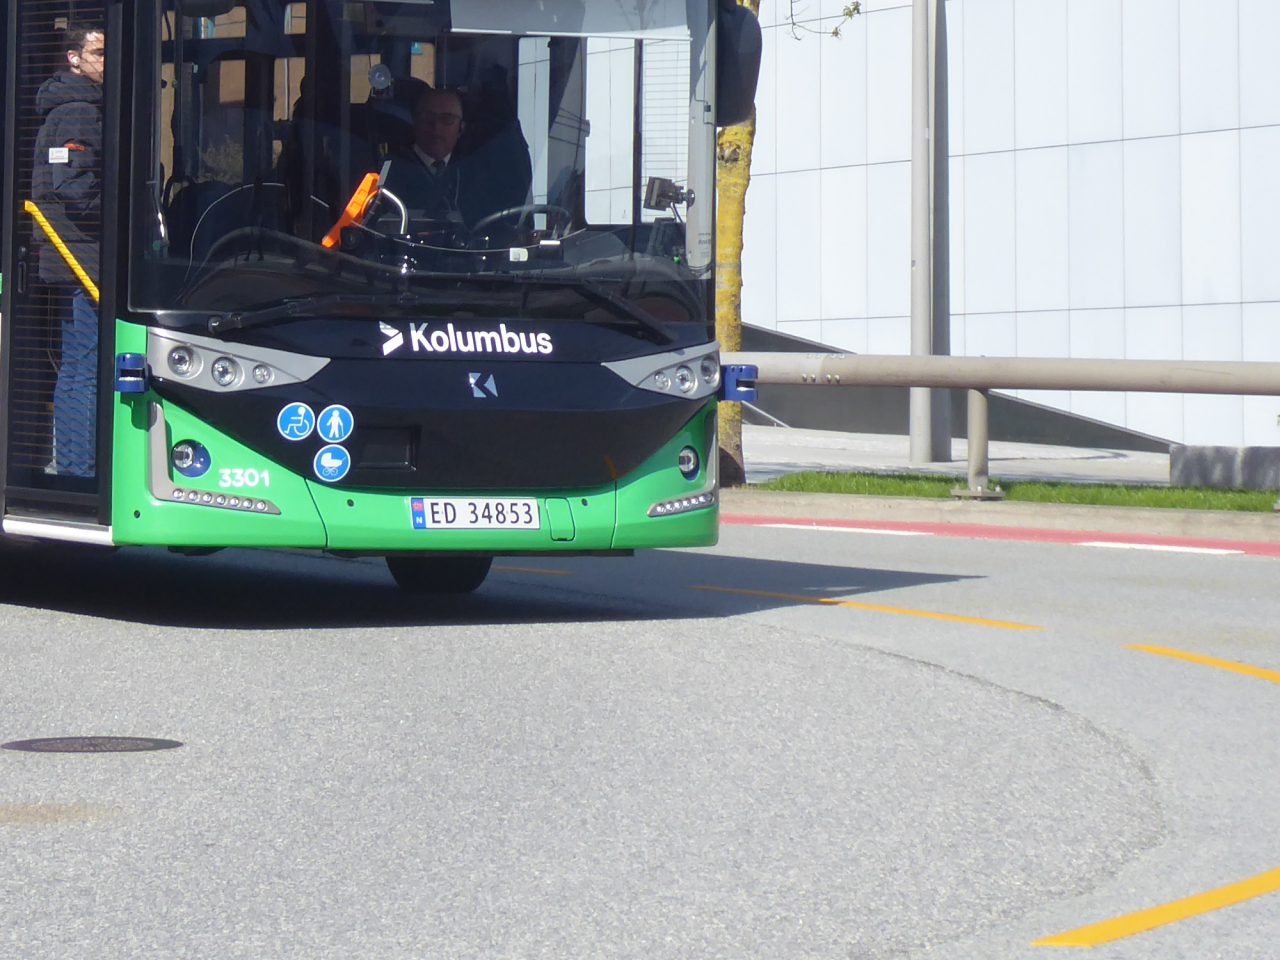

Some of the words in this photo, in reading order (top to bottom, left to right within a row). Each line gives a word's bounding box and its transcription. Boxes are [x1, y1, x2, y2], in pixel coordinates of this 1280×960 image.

[410, 323, 553, 355] Kolumbus
[218, 469, 270, 488] 3301
[430, 502, 457, 524] ED
[468, 502, 533, 525] 34853
